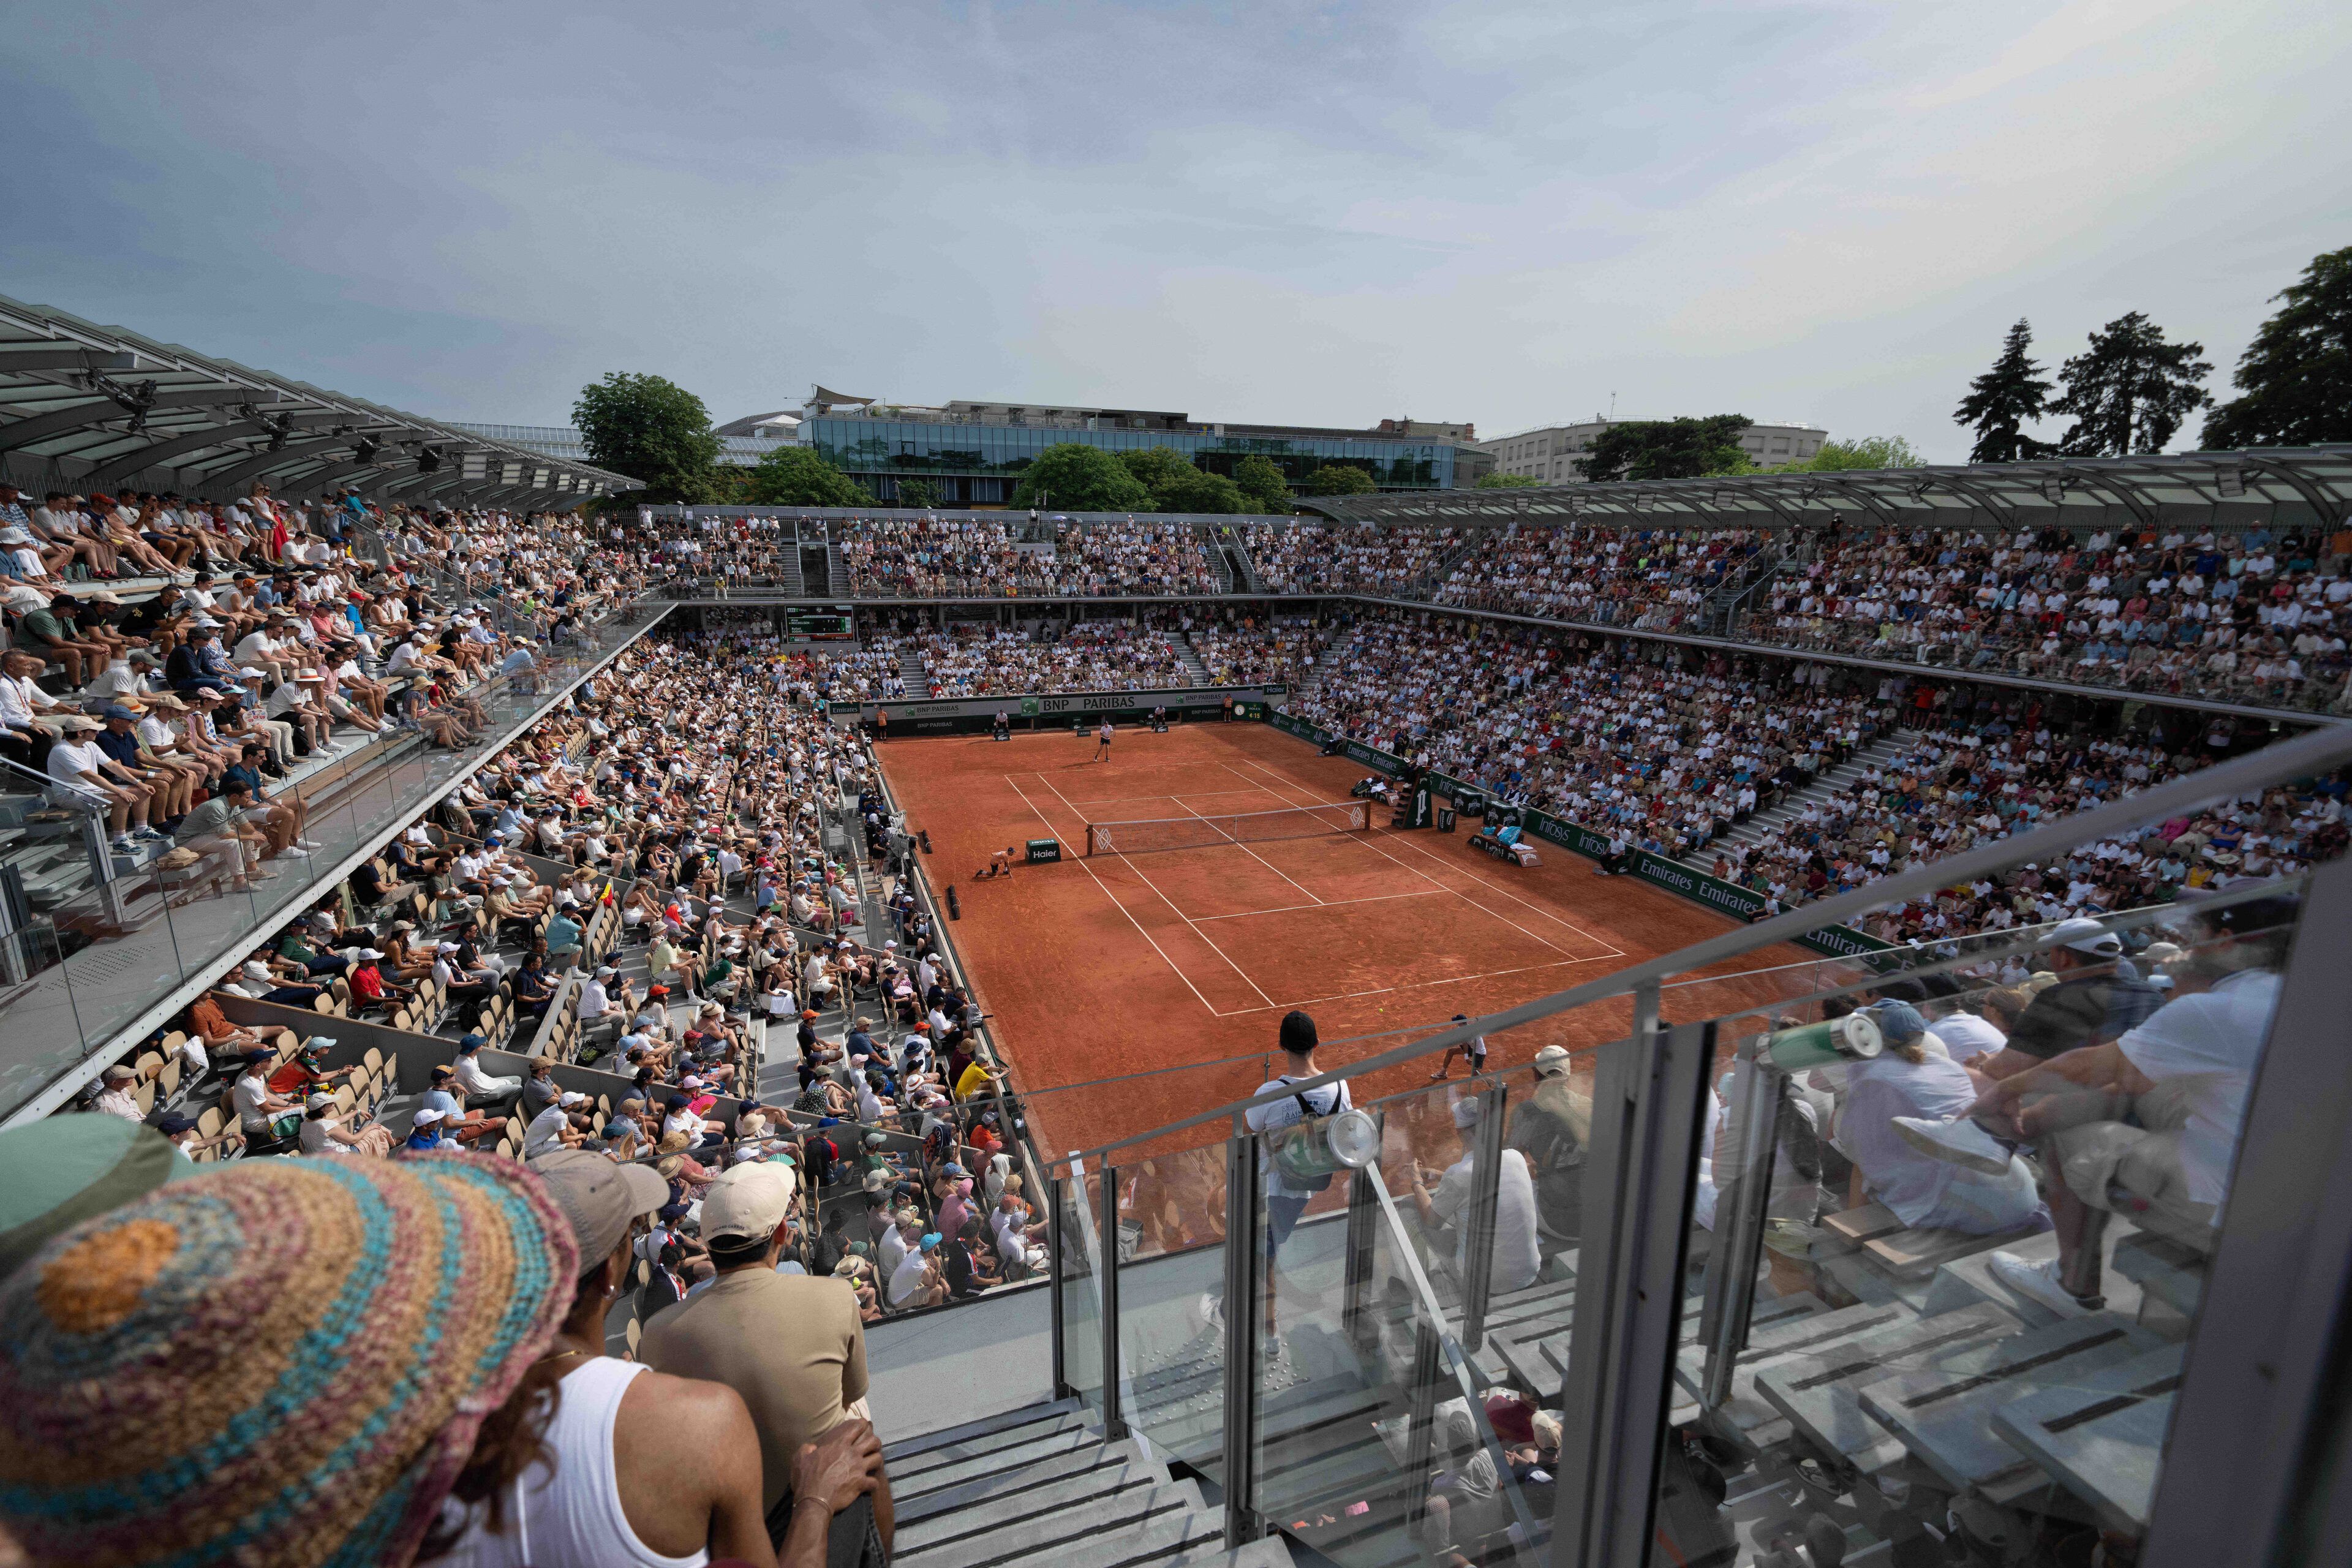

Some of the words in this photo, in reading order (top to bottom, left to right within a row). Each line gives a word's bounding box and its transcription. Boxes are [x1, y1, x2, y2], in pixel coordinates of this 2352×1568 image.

[1043, 699, 1069, 711] BNP
[1084, 696, 1135, 709] PARIBAS
[1272, 715, 1281, 725] All
[1292, 723, 1301, 734] All
[1313, 731, 1323, 743] All
[1348, 744, 1371, 761] Emirates
[1372, 754, 1397, 771] Emirates
[1539, 817, 1570, 842] Infosys
[1033, 850, 1057, 859] Haier
[1640, 858, 1694, 890] Emirates
[1698, 881, 1759, 913] Emirates
